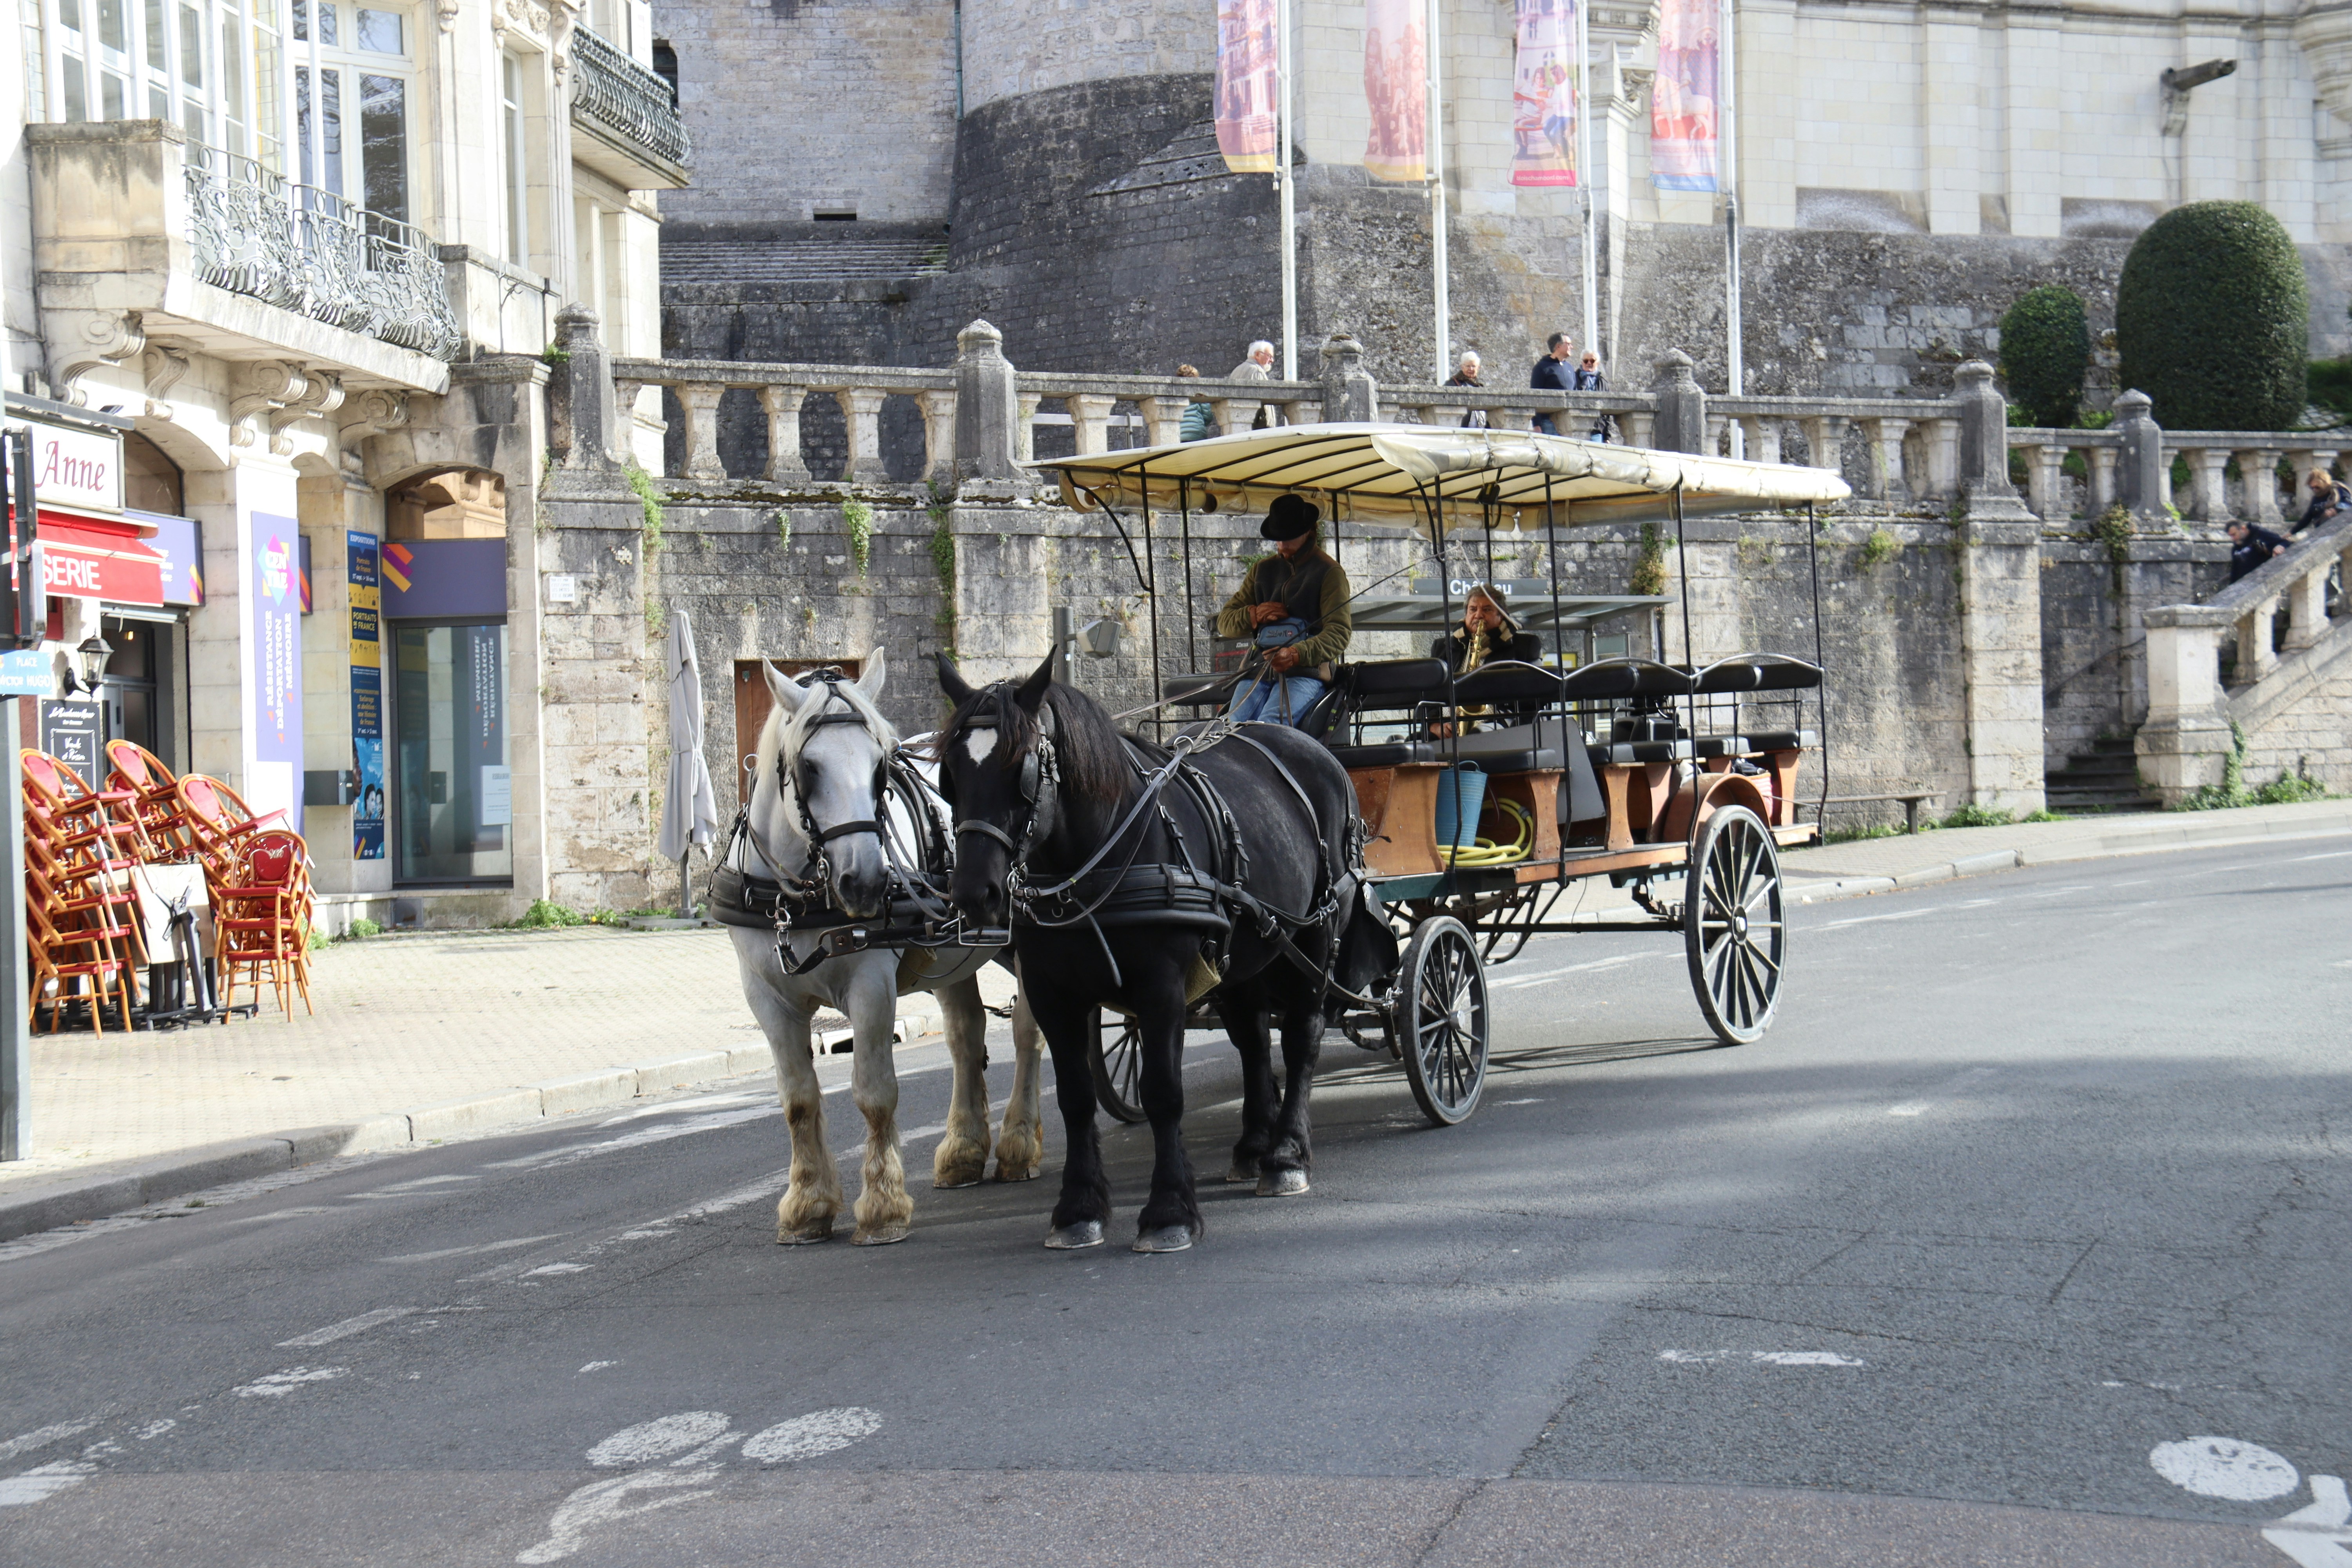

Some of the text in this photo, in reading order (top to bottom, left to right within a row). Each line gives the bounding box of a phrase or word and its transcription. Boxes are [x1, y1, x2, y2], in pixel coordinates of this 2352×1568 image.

[34, 440, 105, 492] Anne
[350, 534, 375, 546] EXPOSITIONS
[1450, 579, 1512, 595] Chau
[353, 612, 377, 622] PORTRAITS
[358, 621, 375, 631] FRANCE
[265, 610, 274, 706] RÉSISTANCE
[285, 613, 293, 689] MÉMOIRE
[16, 657, 38, 667] PLACE
[26, 674, 51, 687] HUGO
[275, 618, 284, 730] DÉPORTATION
